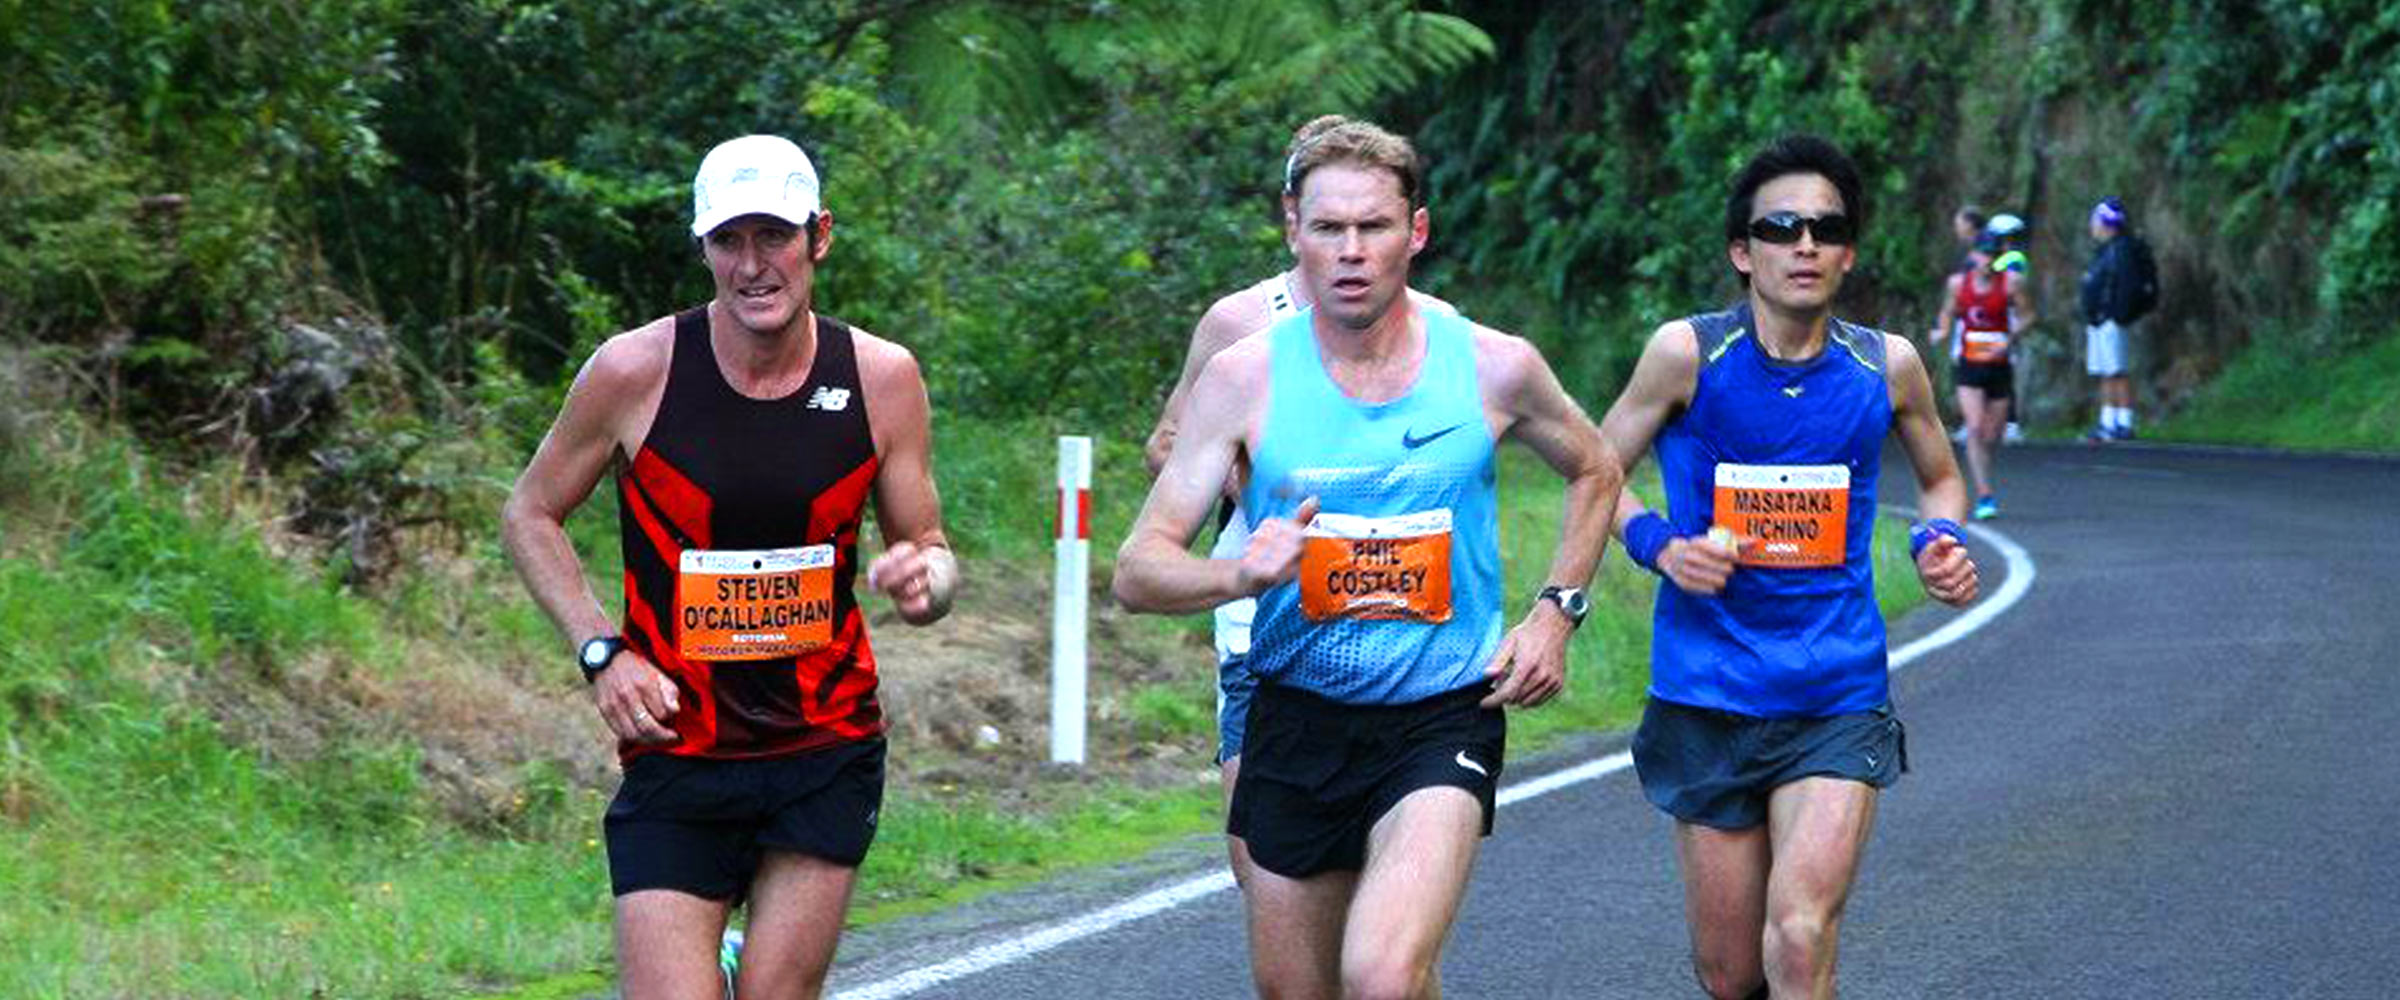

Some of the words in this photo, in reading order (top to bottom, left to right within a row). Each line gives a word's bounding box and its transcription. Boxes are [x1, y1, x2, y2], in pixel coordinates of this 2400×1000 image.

[1733, 489, 1832, 514] MASATAKA
[1746, 516, 1819, 540] UCHINO
[1353, 541, 1401, 565] PHIL
[716, 575, 800, 601] STEVEN
[1327, 566, 1428, 595] COSTLEY
[684, 600, 830, 630] O'CALLAGHAN
